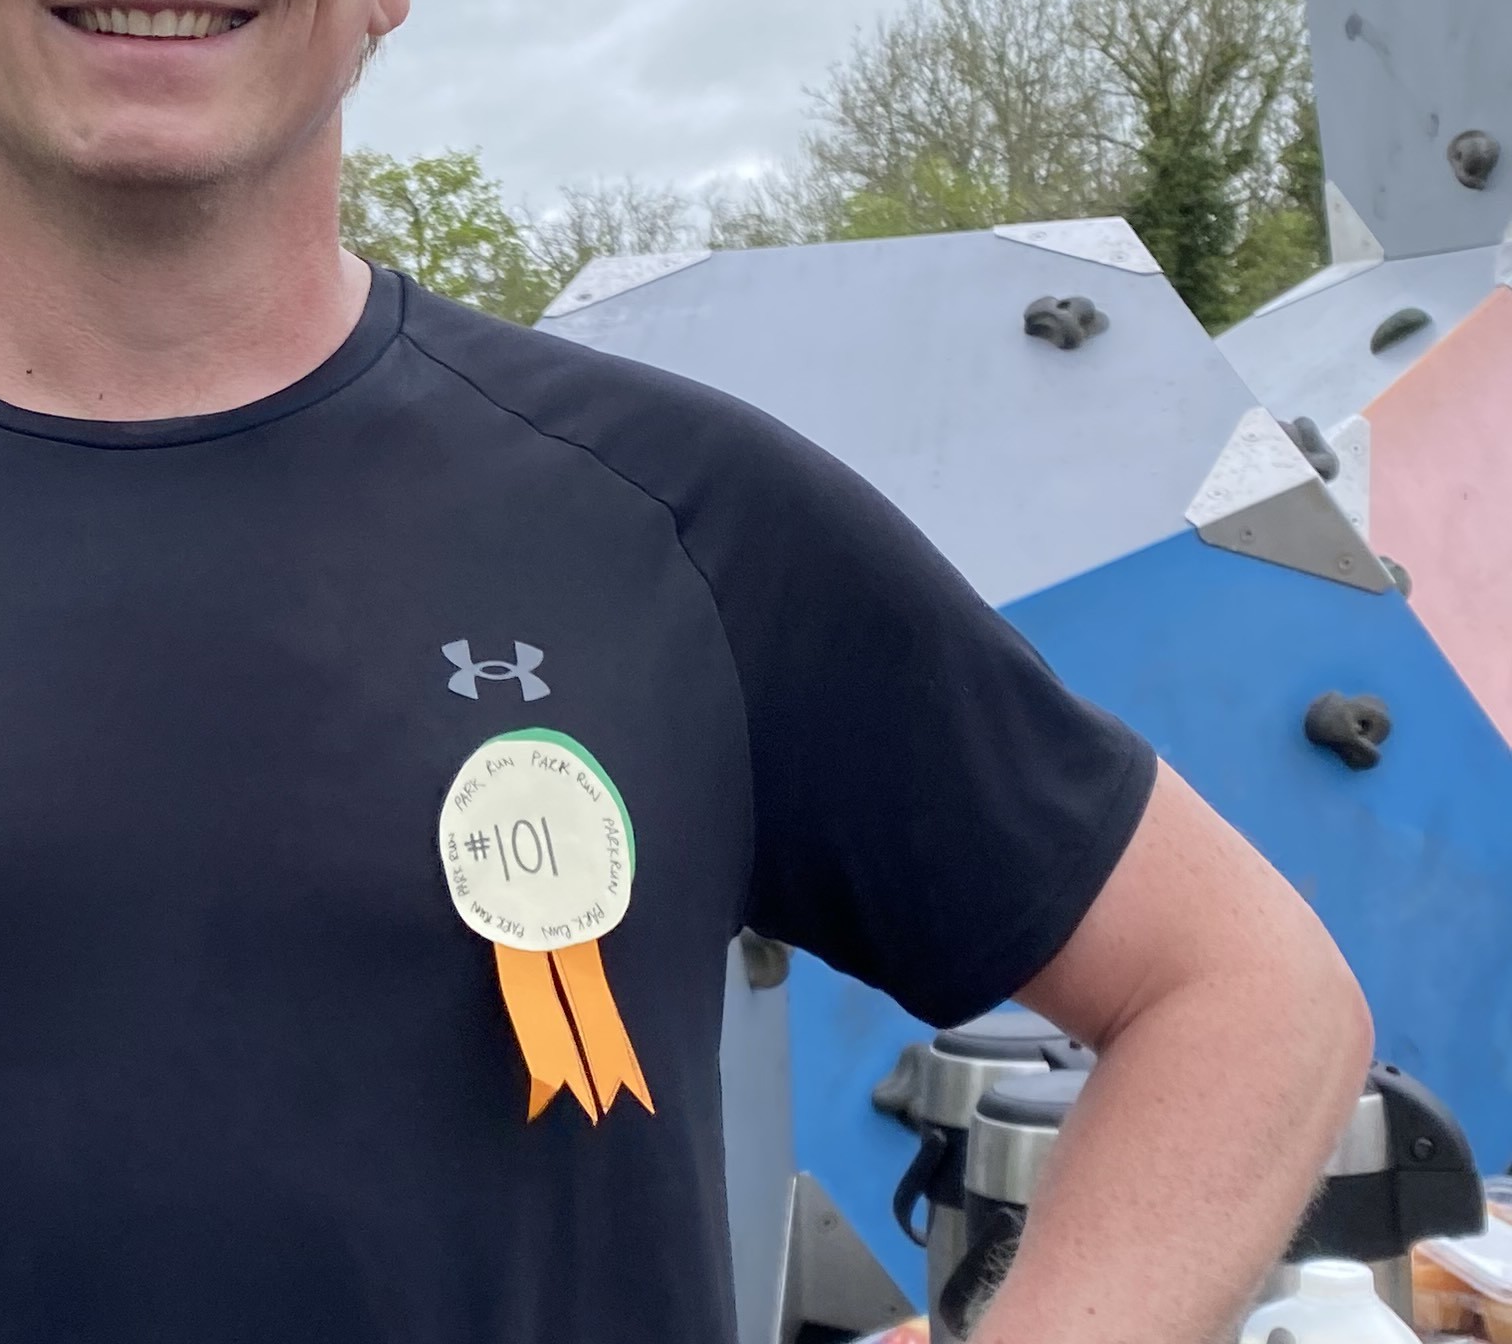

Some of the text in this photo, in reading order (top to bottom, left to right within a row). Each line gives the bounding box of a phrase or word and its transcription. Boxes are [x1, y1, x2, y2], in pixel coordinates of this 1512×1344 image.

[454, 755, 515, 812] PARK RUN
[531, 750, 601, 802] PARK RUN
[464, 816, 559, 882] #101
[541, 902, 605, 939] PARK RUN
